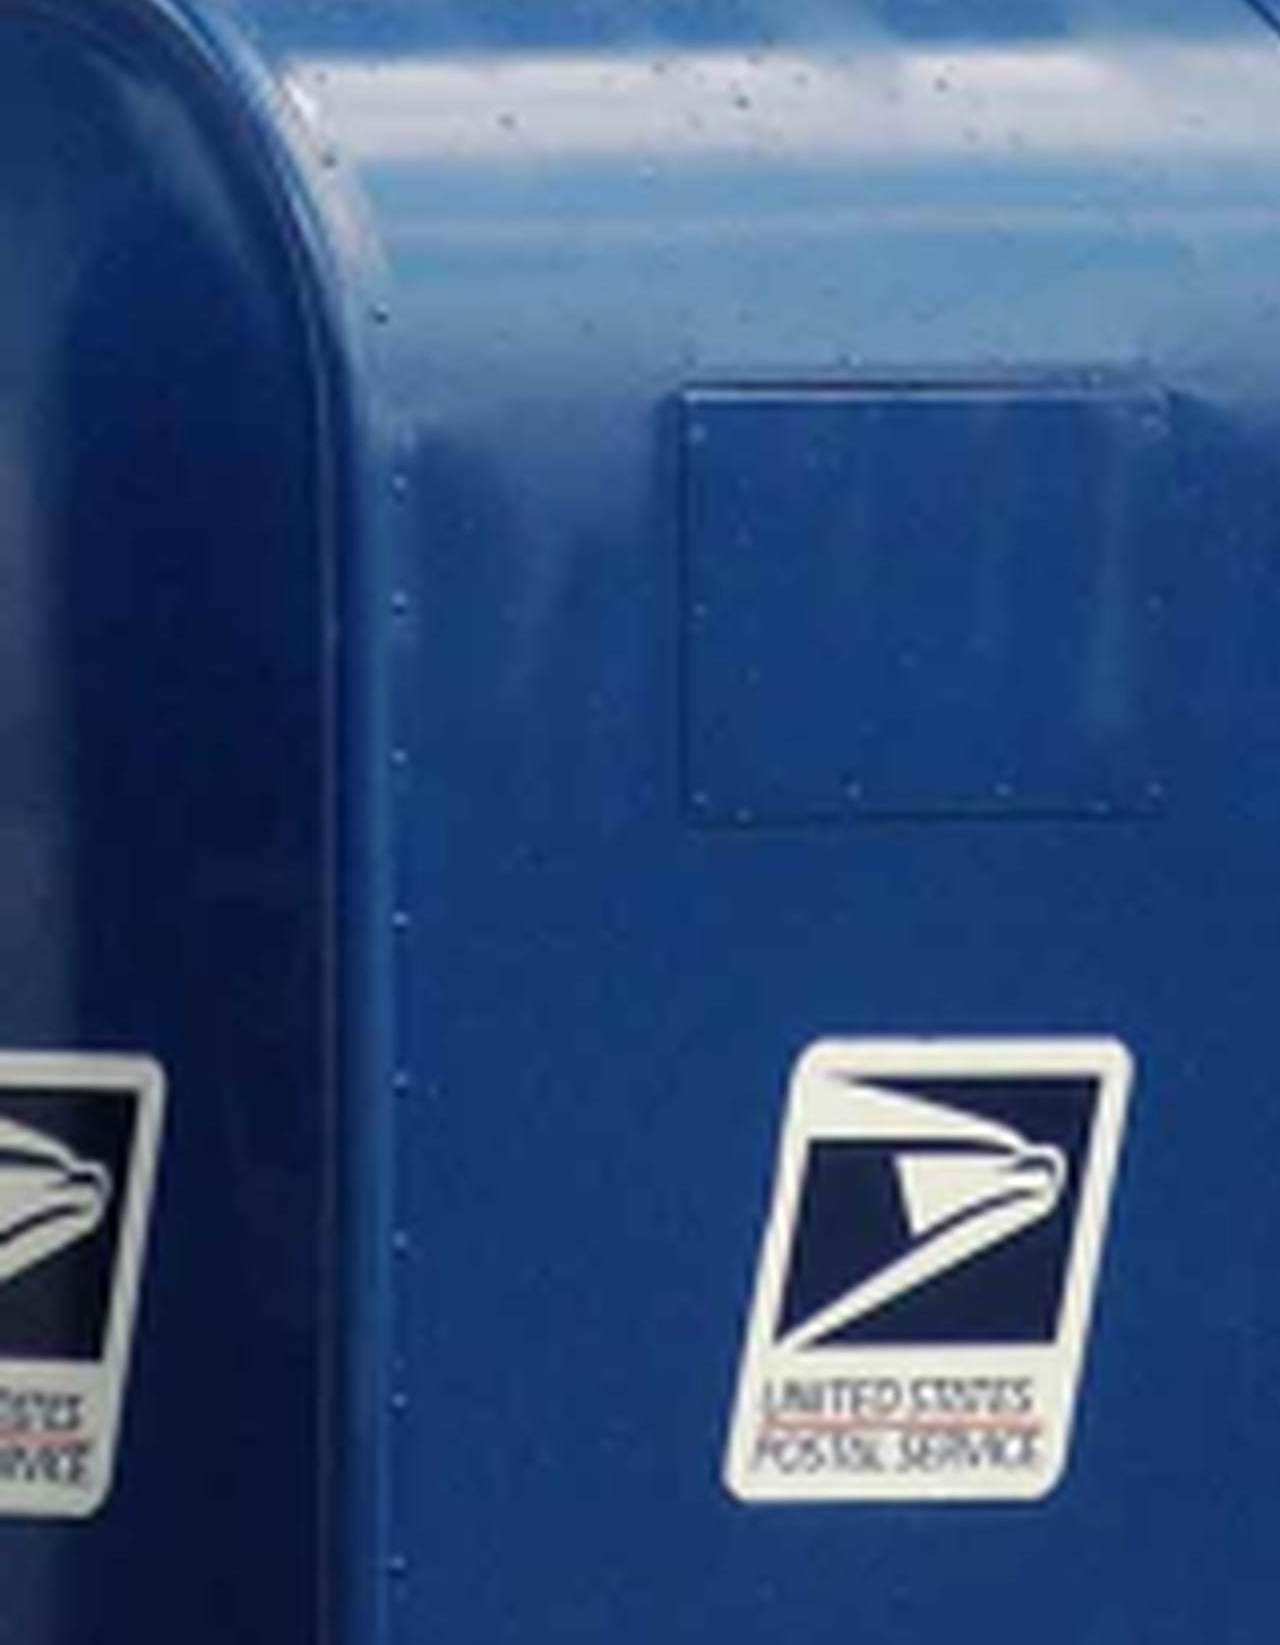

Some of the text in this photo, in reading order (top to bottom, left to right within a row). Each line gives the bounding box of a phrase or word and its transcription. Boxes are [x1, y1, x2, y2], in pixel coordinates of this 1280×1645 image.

[762, 1376, 1034, 1413] UNITED STATES
[751, 1429, 1039, 1474] POSTAL SERVICE
